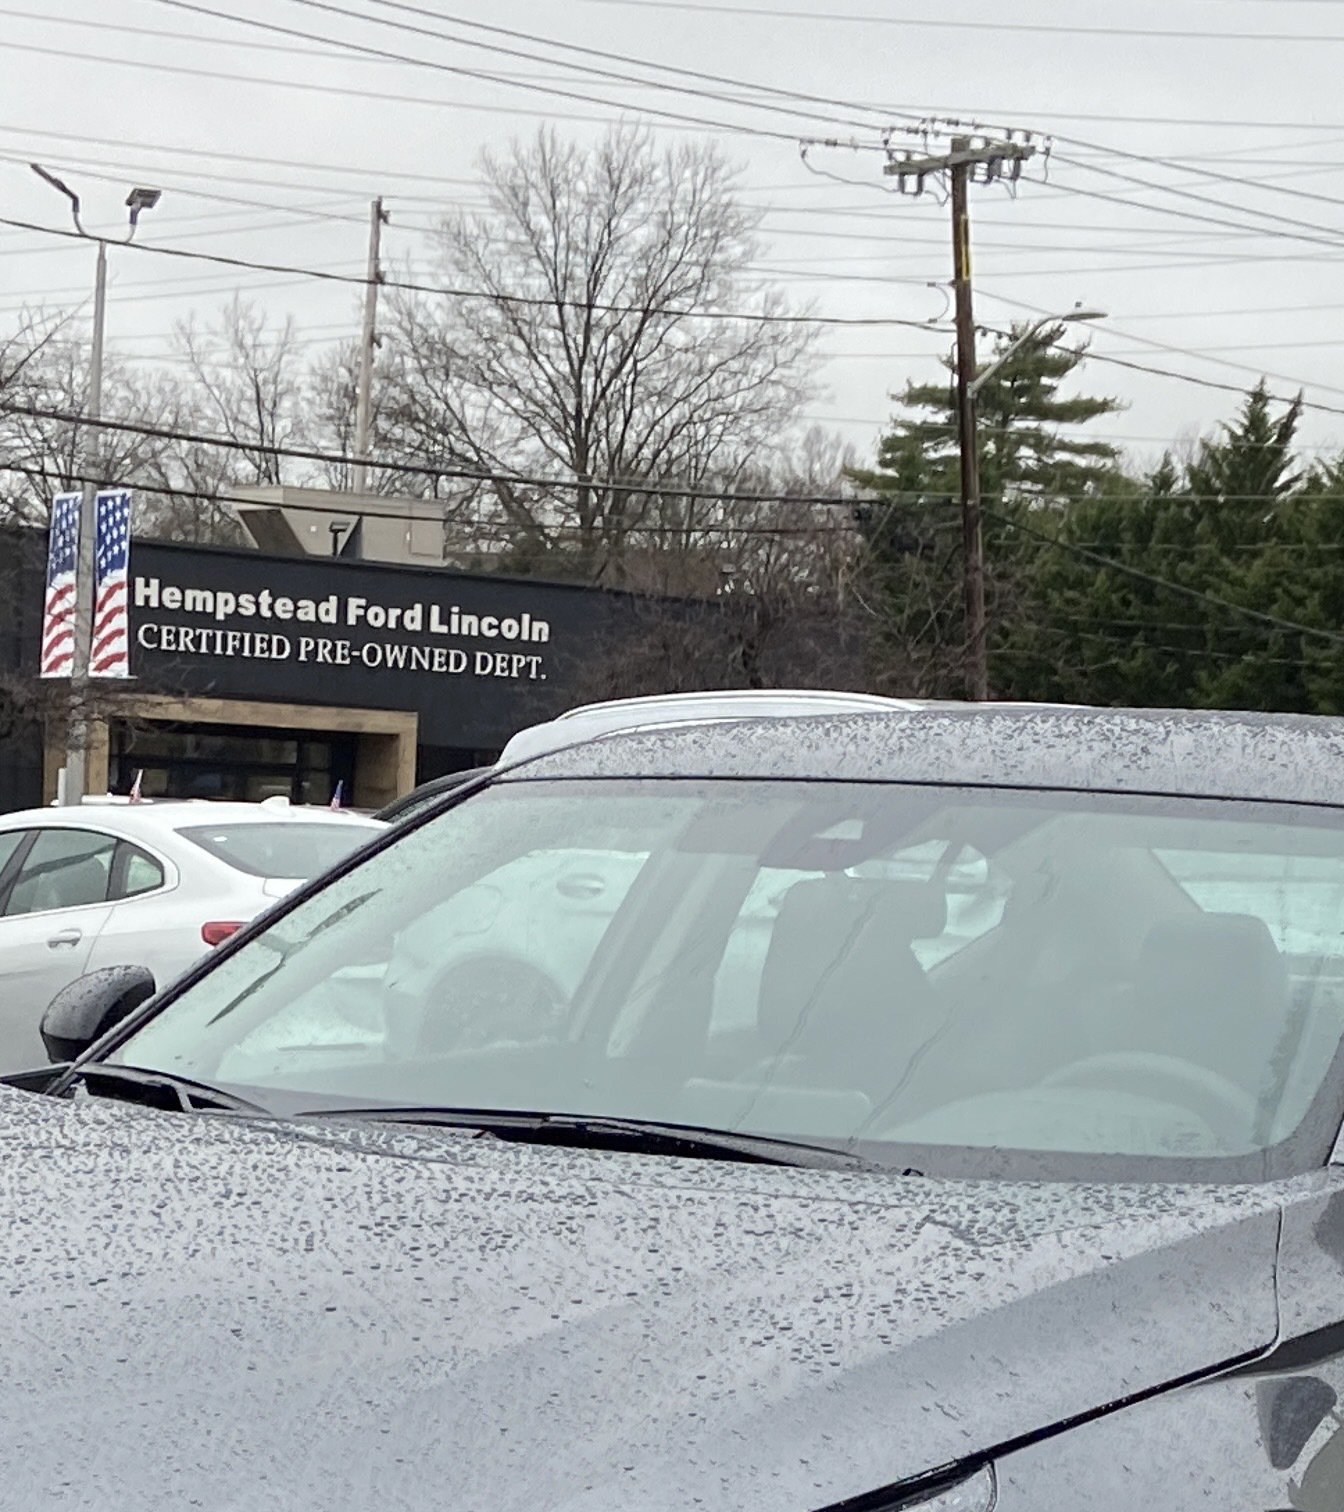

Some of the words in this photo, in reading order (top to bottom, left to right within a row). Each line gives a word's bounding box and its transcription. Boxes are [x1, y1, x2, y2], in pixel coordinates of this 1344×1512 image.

[134, 576, 339, 625] Hempstead
[346, 596, 423, 632] Ford
[429, 604, 550, 643] Lincoln
[137, 622, 292, 660] CERTIFIED
[297, 635, 468, 674] PRE-OWNED
[474, 651, 547, 680] DEPT.
